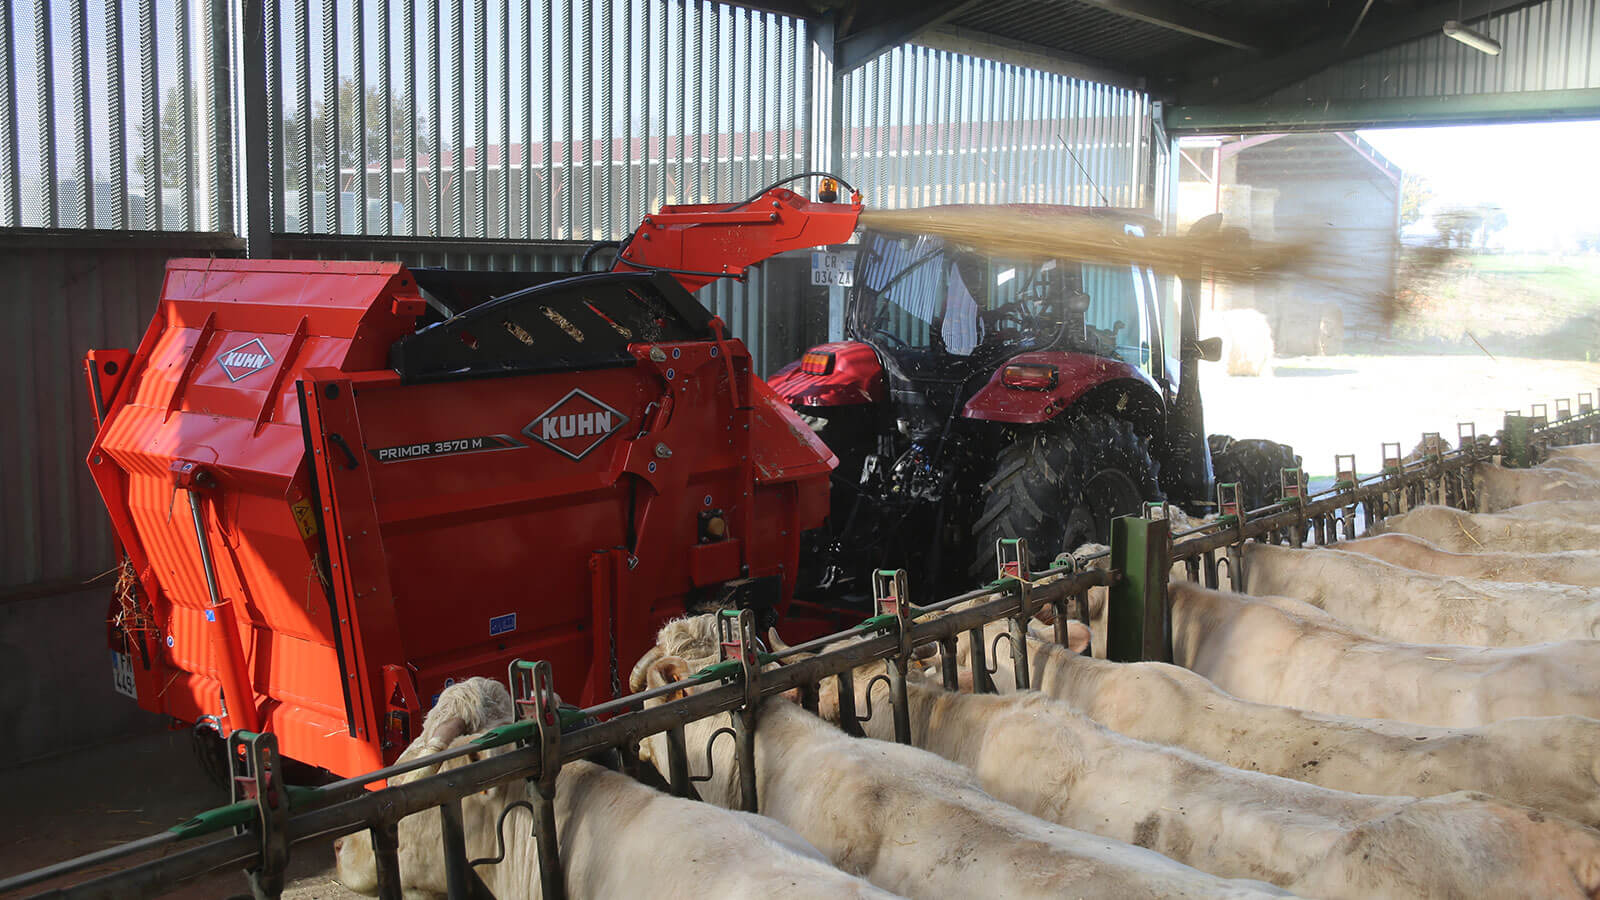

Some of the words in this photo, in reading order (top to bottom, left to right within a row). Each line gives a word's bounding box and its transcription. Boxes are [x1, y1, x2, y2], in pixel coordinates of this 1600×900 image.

[224, 352, 267, 369] KUHN
[543, 411, 611, 440] KUHN
[379, 444, 430, 460] PRIMOR
[435, 440, 468, 453] 3570
[472, 438, 482, 449] M
